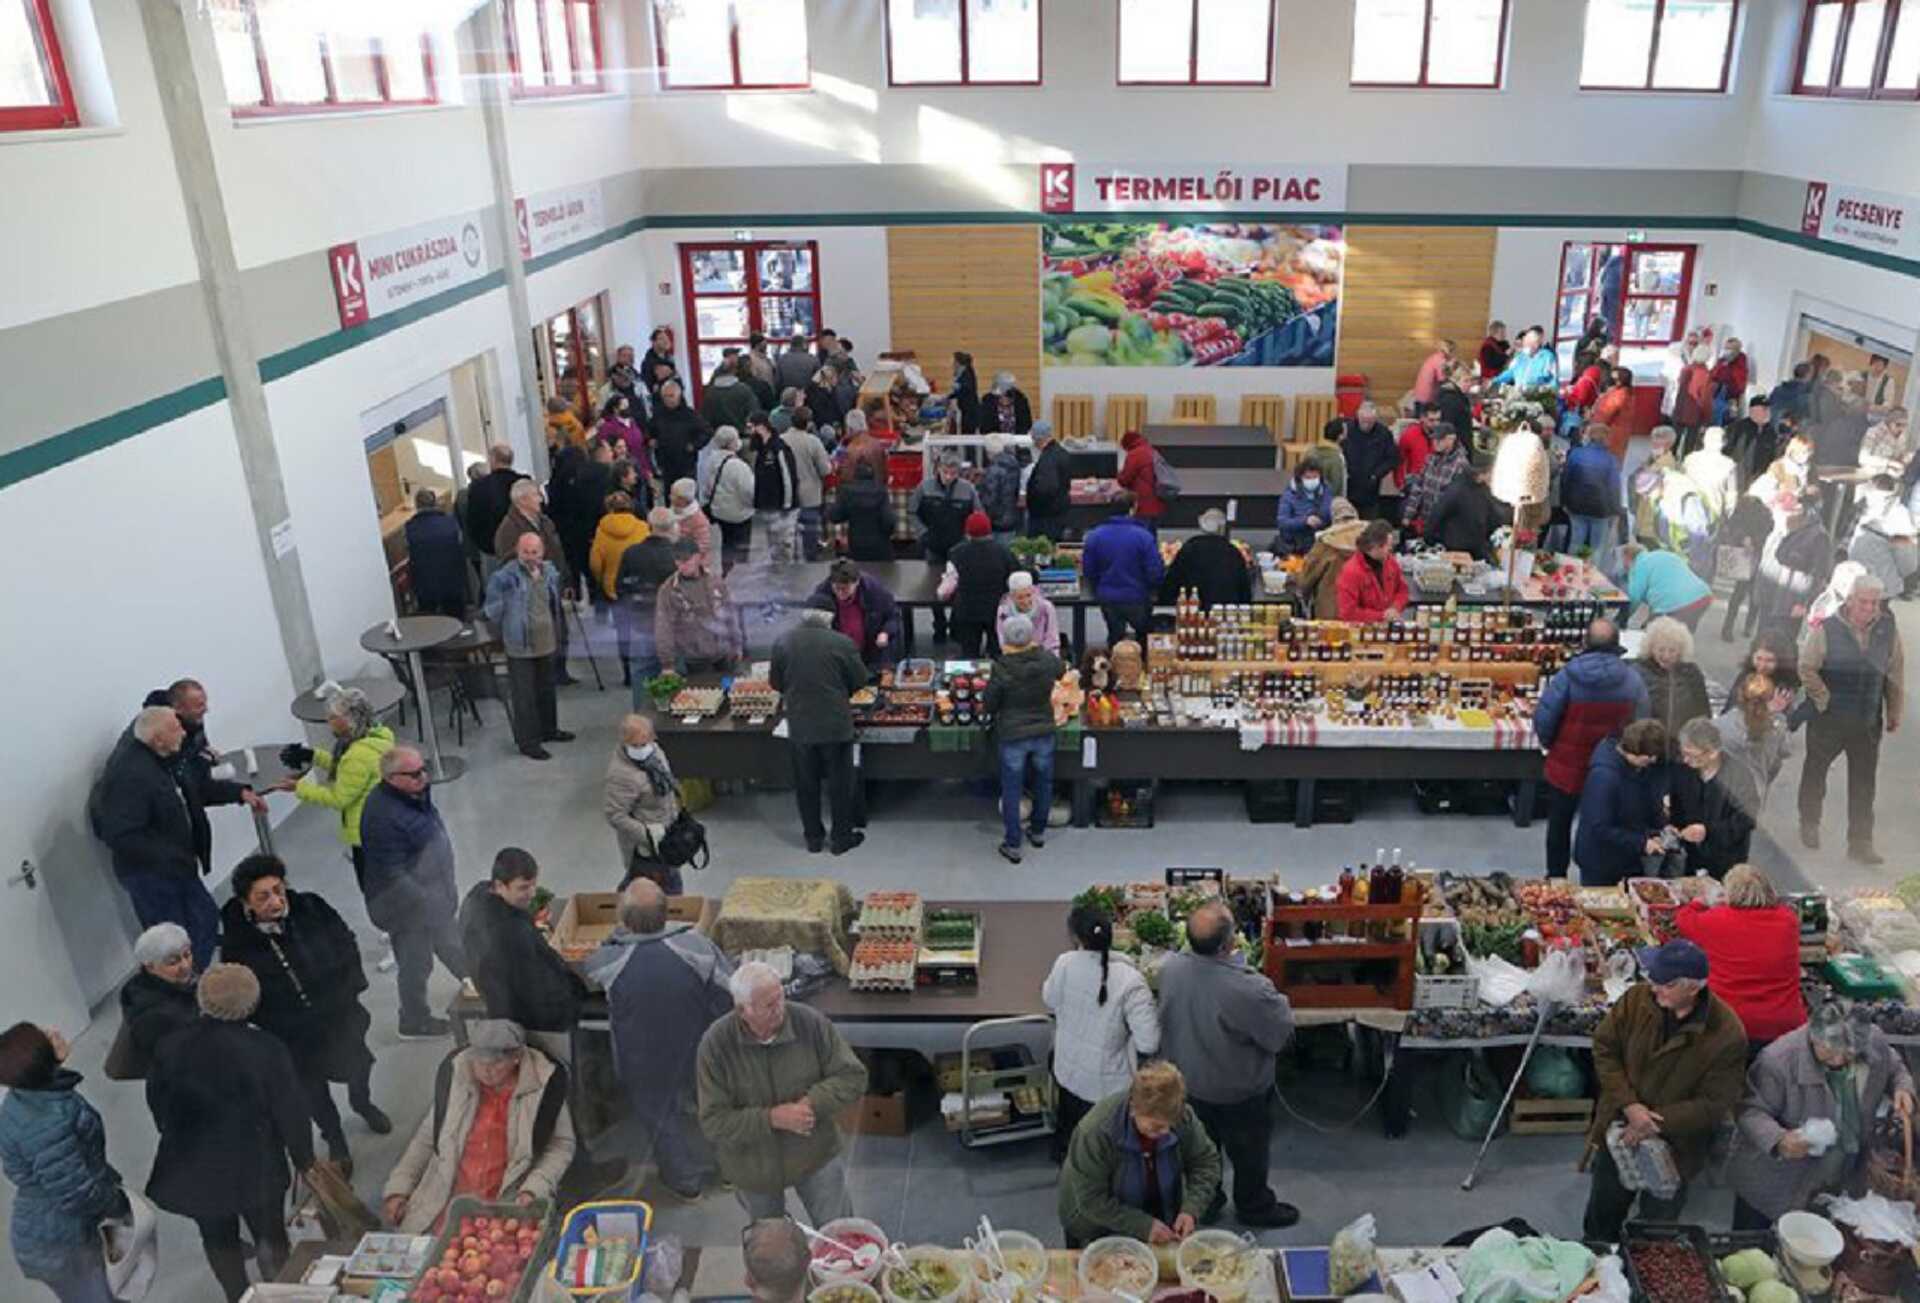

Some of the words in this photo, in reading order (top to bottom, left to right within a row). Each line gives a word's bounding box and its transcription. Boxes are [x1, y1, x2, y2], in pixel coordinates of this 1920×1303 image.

[1045, 169, 1070, 193] K
[1094, 170, 1243, 201] TERMELŐI
[1251, 177, 1321, 202] PIAC
[1836, 198, 1902, 229] PECSENYE
